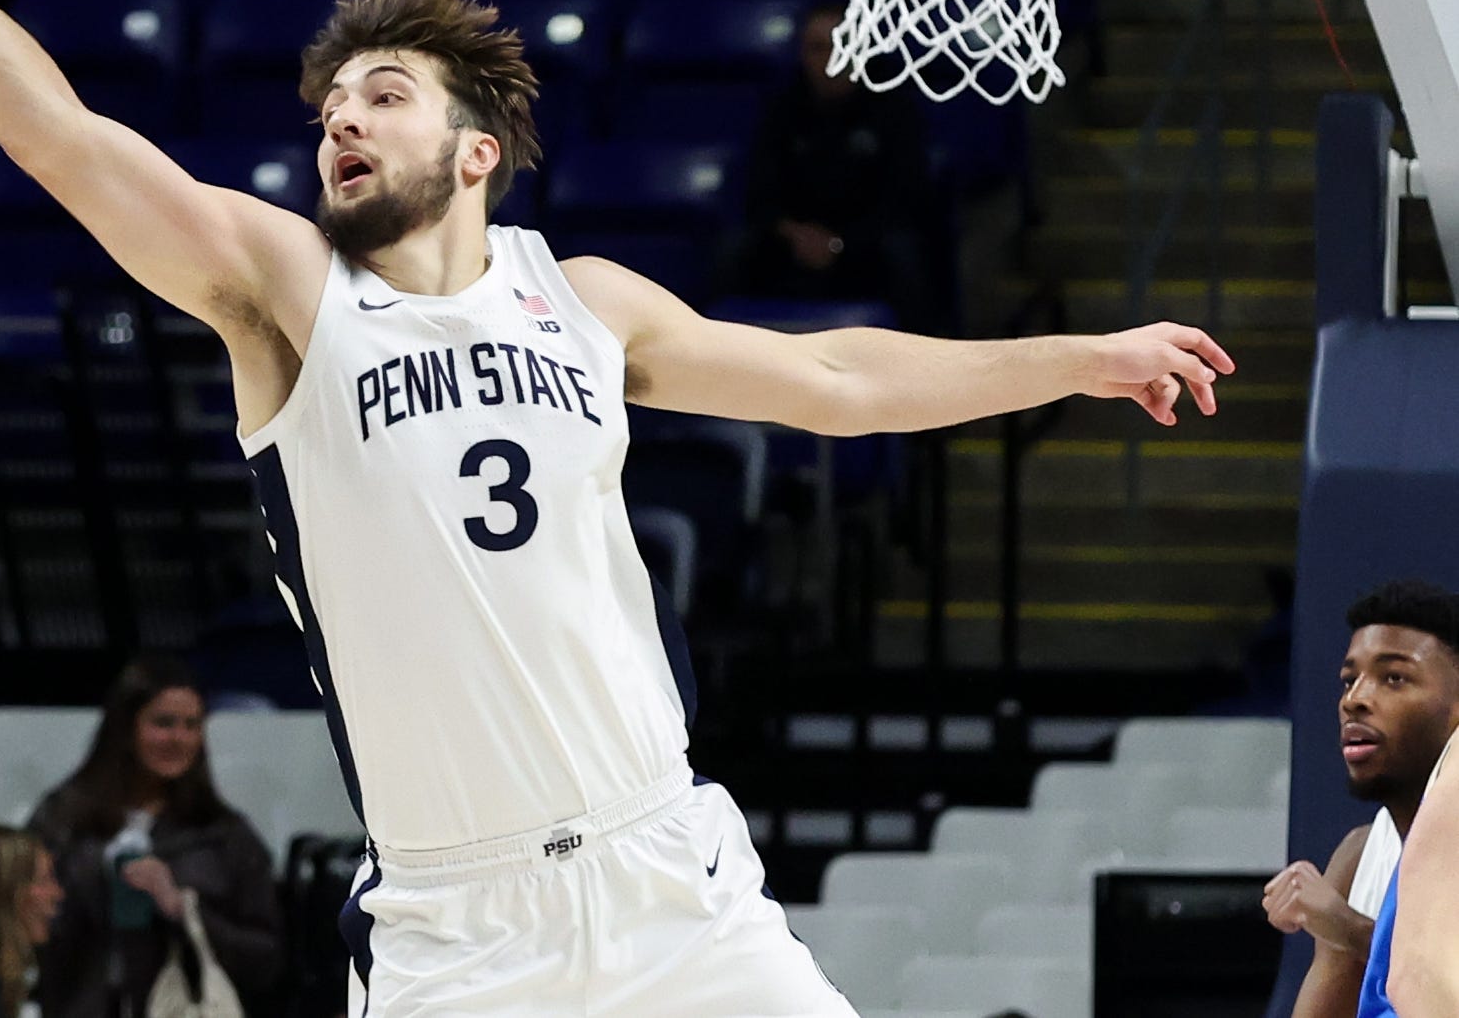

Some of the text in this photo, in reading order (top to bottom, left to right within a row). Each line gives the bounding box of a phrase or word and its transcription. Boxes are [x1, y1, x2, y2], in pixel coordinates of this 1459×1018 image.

[357, 342, 602, 442] PENN STATE
[458, 438, 539, 552] 3
[542, 833, 582, 857] PSU
